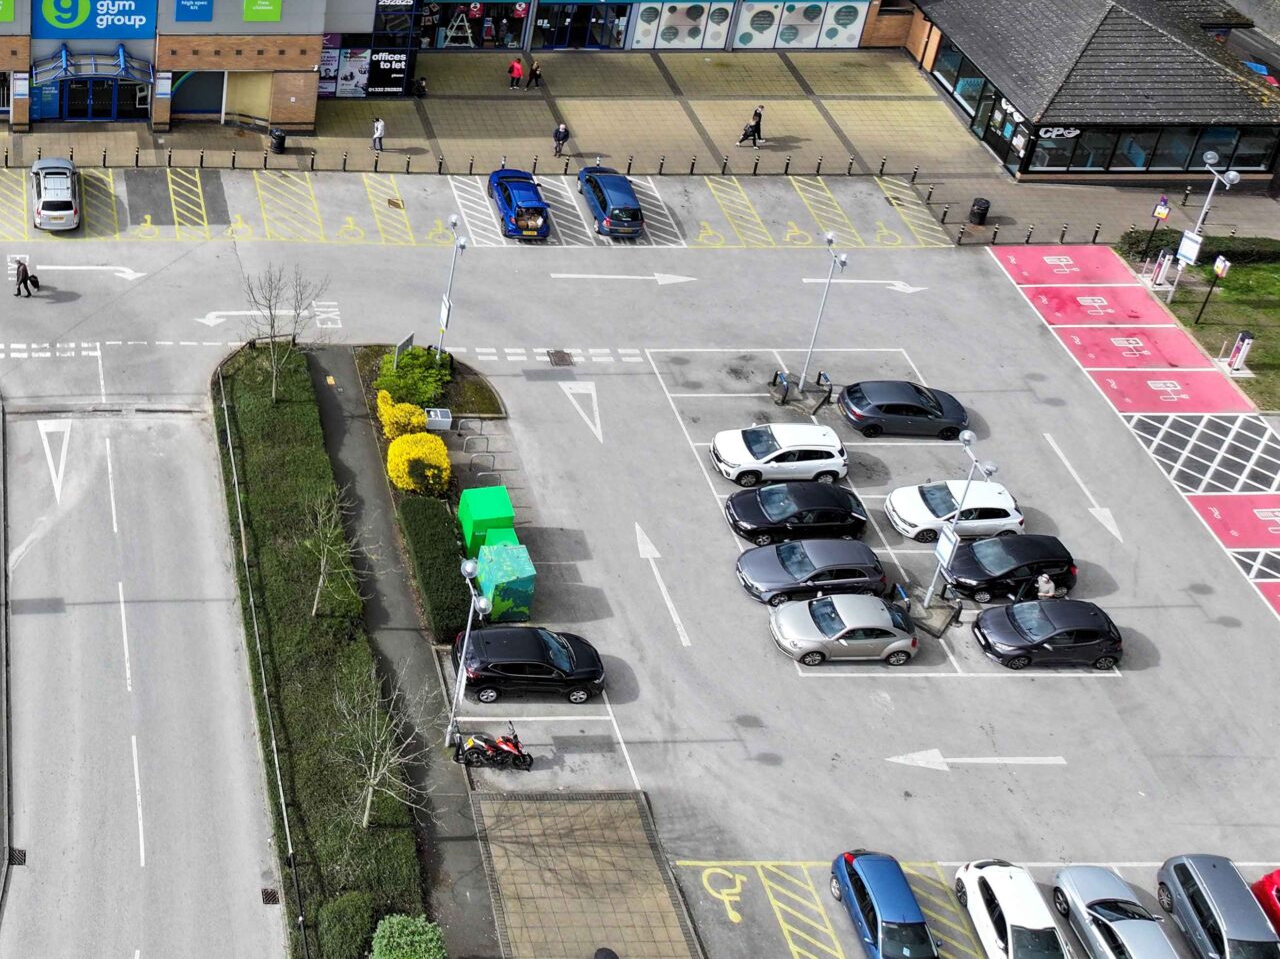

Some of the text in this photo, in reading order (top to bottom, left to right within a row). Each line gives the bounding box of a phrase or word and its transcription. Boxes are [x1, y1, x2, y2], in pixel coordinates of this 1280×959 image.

[96, 0, 135, 14] gym
[96, 15, 147, 29] group
[372, 52, 407, 61] offices
[380, 61, 406, 69] to let
[311, 300, 343, 329] EXIT
